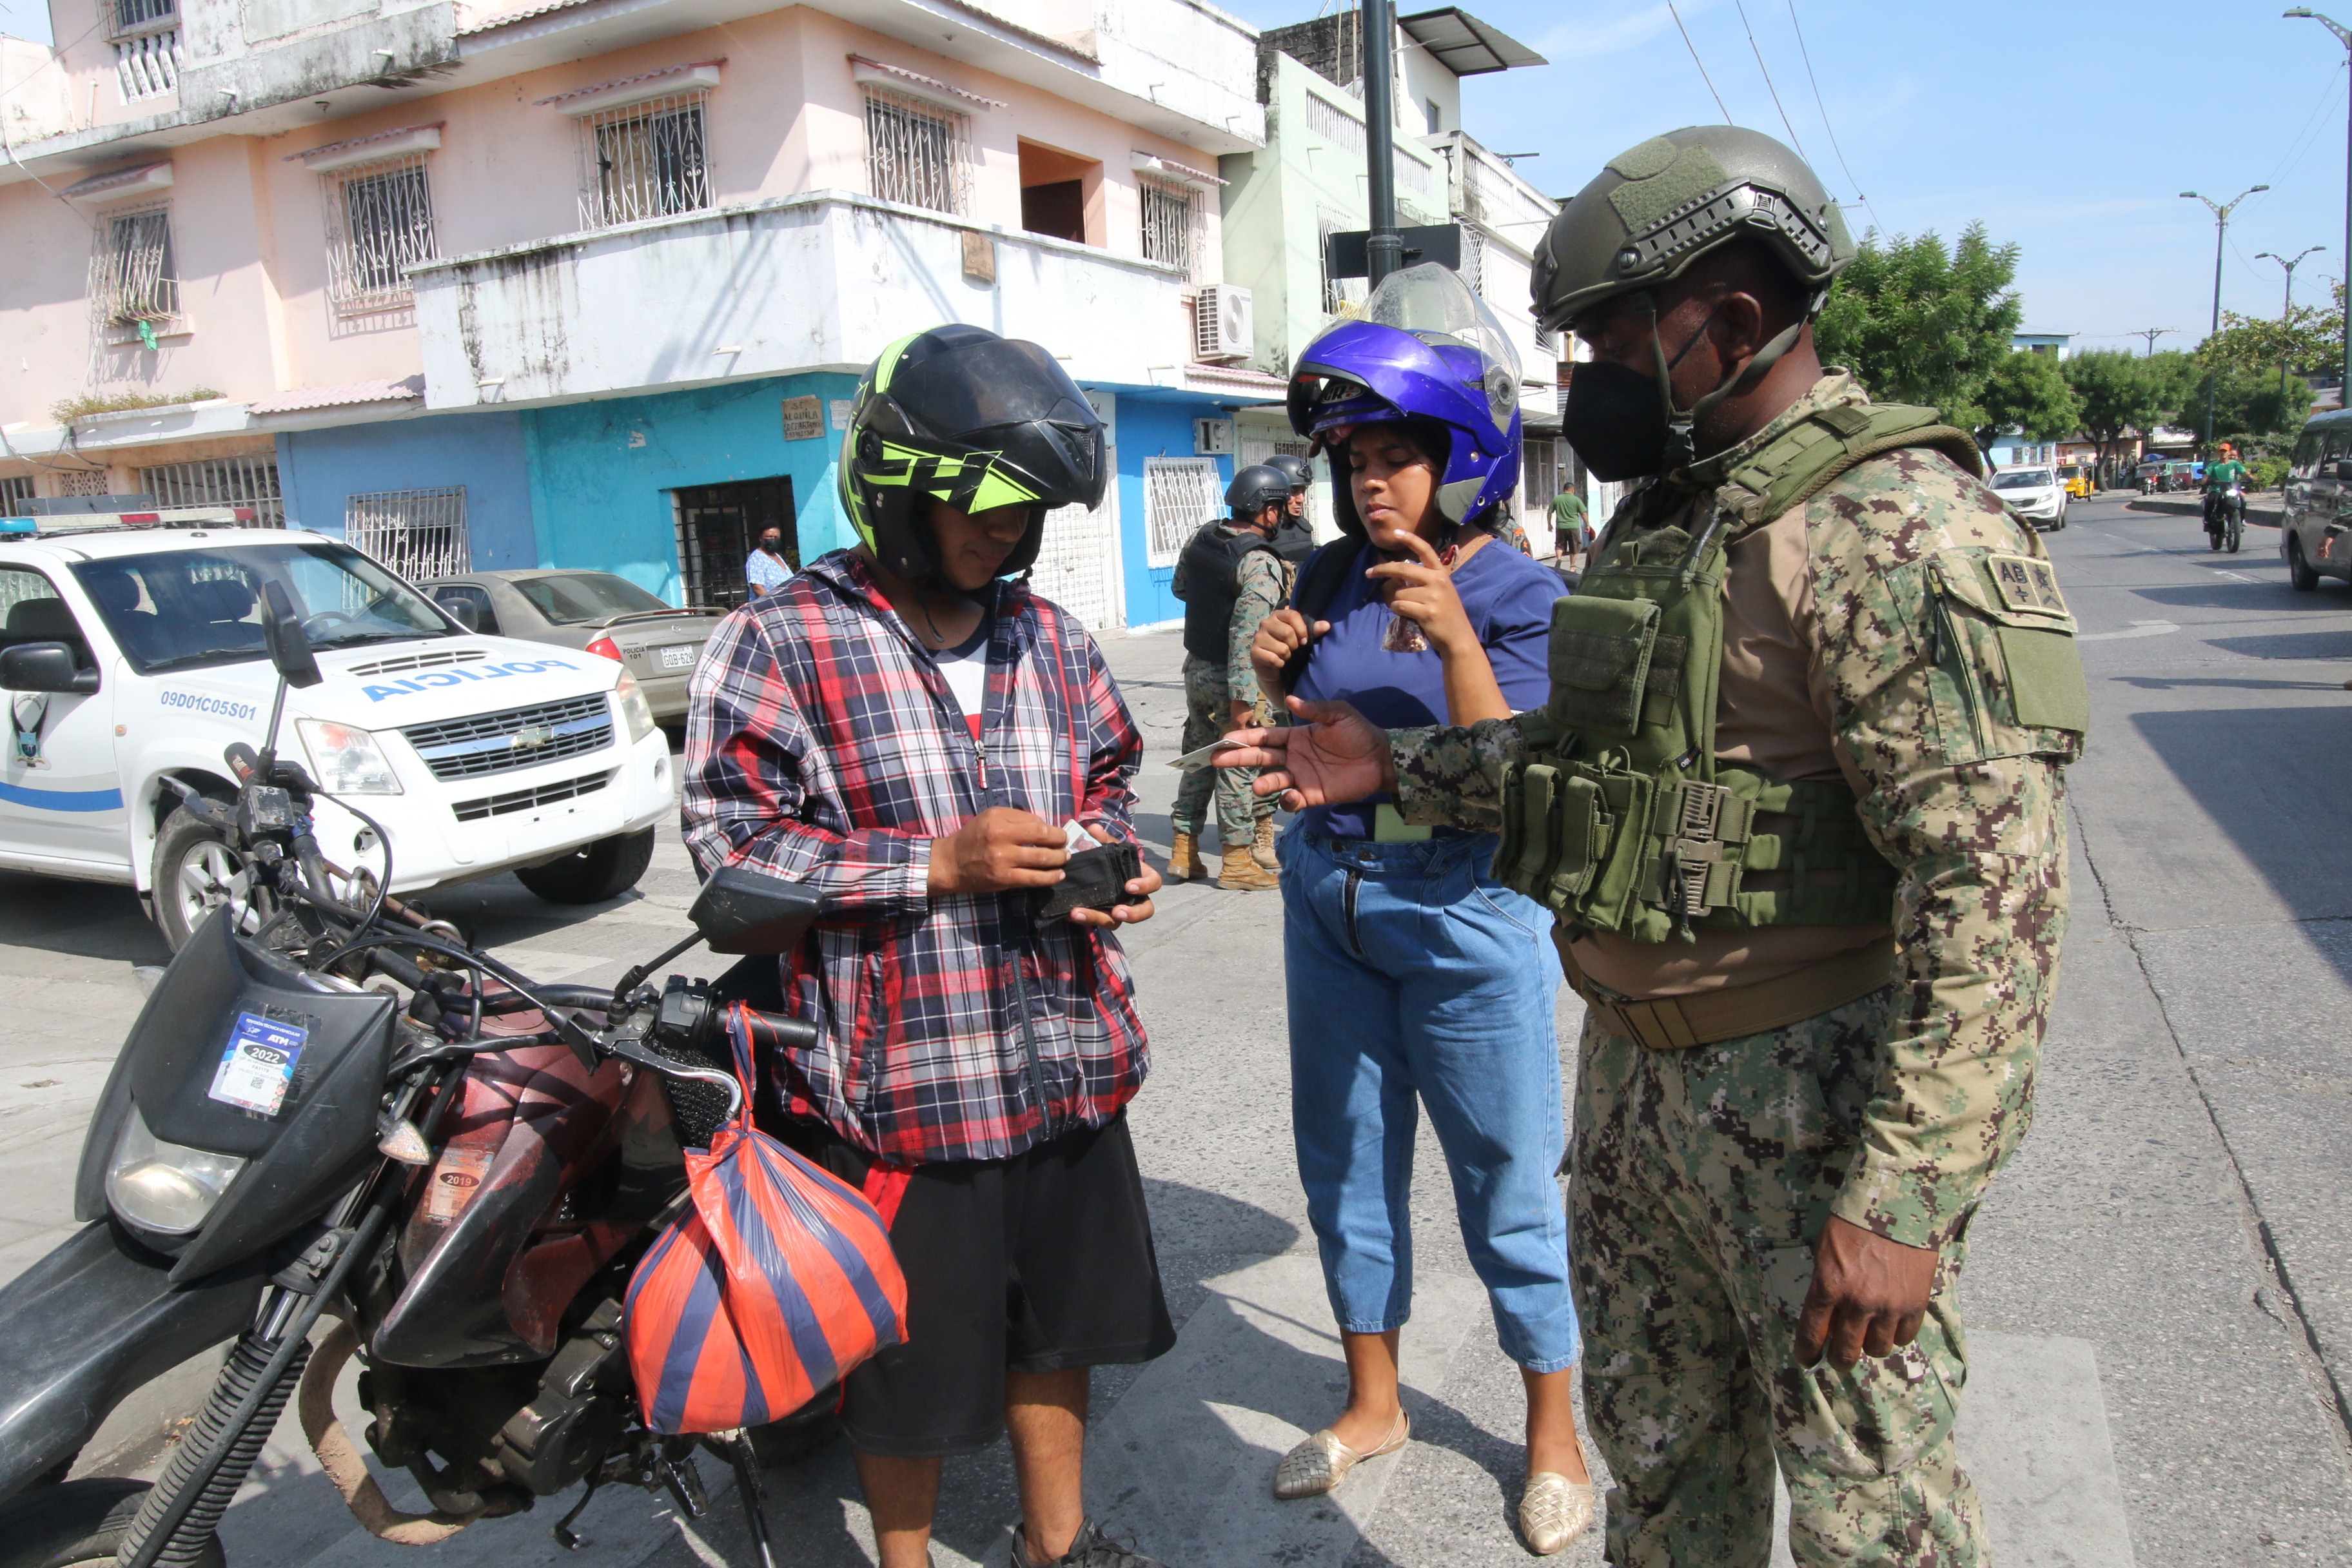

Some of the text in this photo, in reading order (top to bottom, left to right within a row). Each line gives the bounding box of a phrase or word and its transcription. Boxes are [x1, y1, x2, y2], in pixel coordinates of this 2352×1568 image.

[2001, 562, 2028, 583] AB
[161, 691, 257, 721] 09D01C05S01
[267, 1034, 289, 1046] ATM
[250, 1047, 280, 1064] 2022
[446, 1175, 472, 1186] 2019
